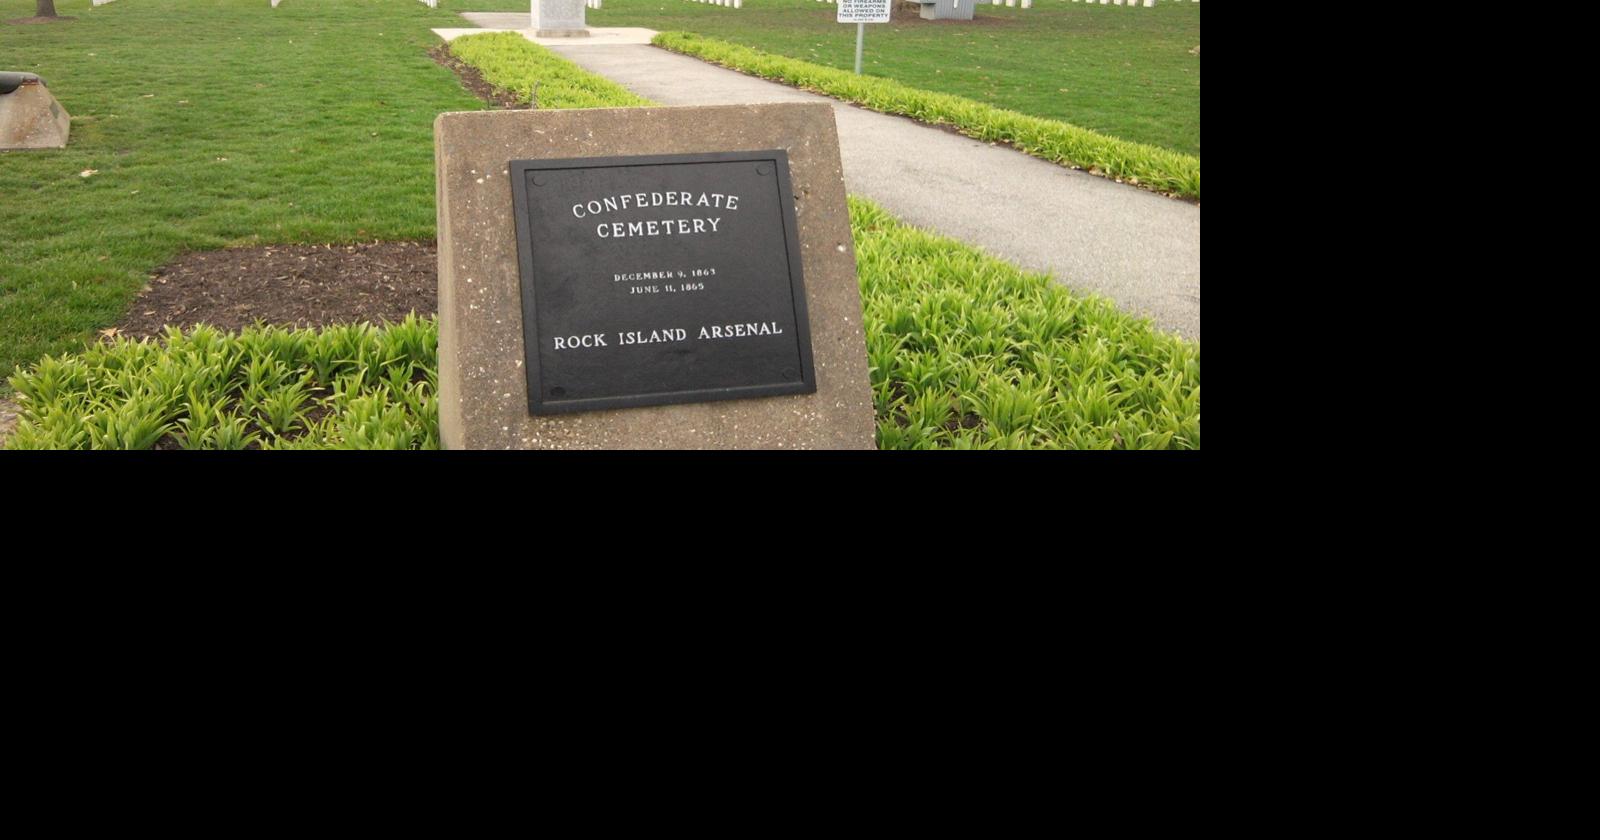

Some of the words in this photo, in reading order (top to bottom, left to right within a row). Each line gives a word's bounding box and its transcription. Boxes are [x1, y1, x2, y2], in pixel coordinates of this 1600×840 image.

[572, 191, 739, 218] CONFEDERATE
[596, 218, 721, 238] CEMETERY
[613, 271, 673, 282] DECEMBER
[692, 268, 716, 277] 1863
[630, 285, 660, 295] JUNE
[664, 284, 676, 293] 11,
[680, 282, 705, 292] 1865
[553, 333, 608, 350] ROCK
[618, 328, 687, 345] ISLAND
[698, 321, 783, 340] ARSENAL
